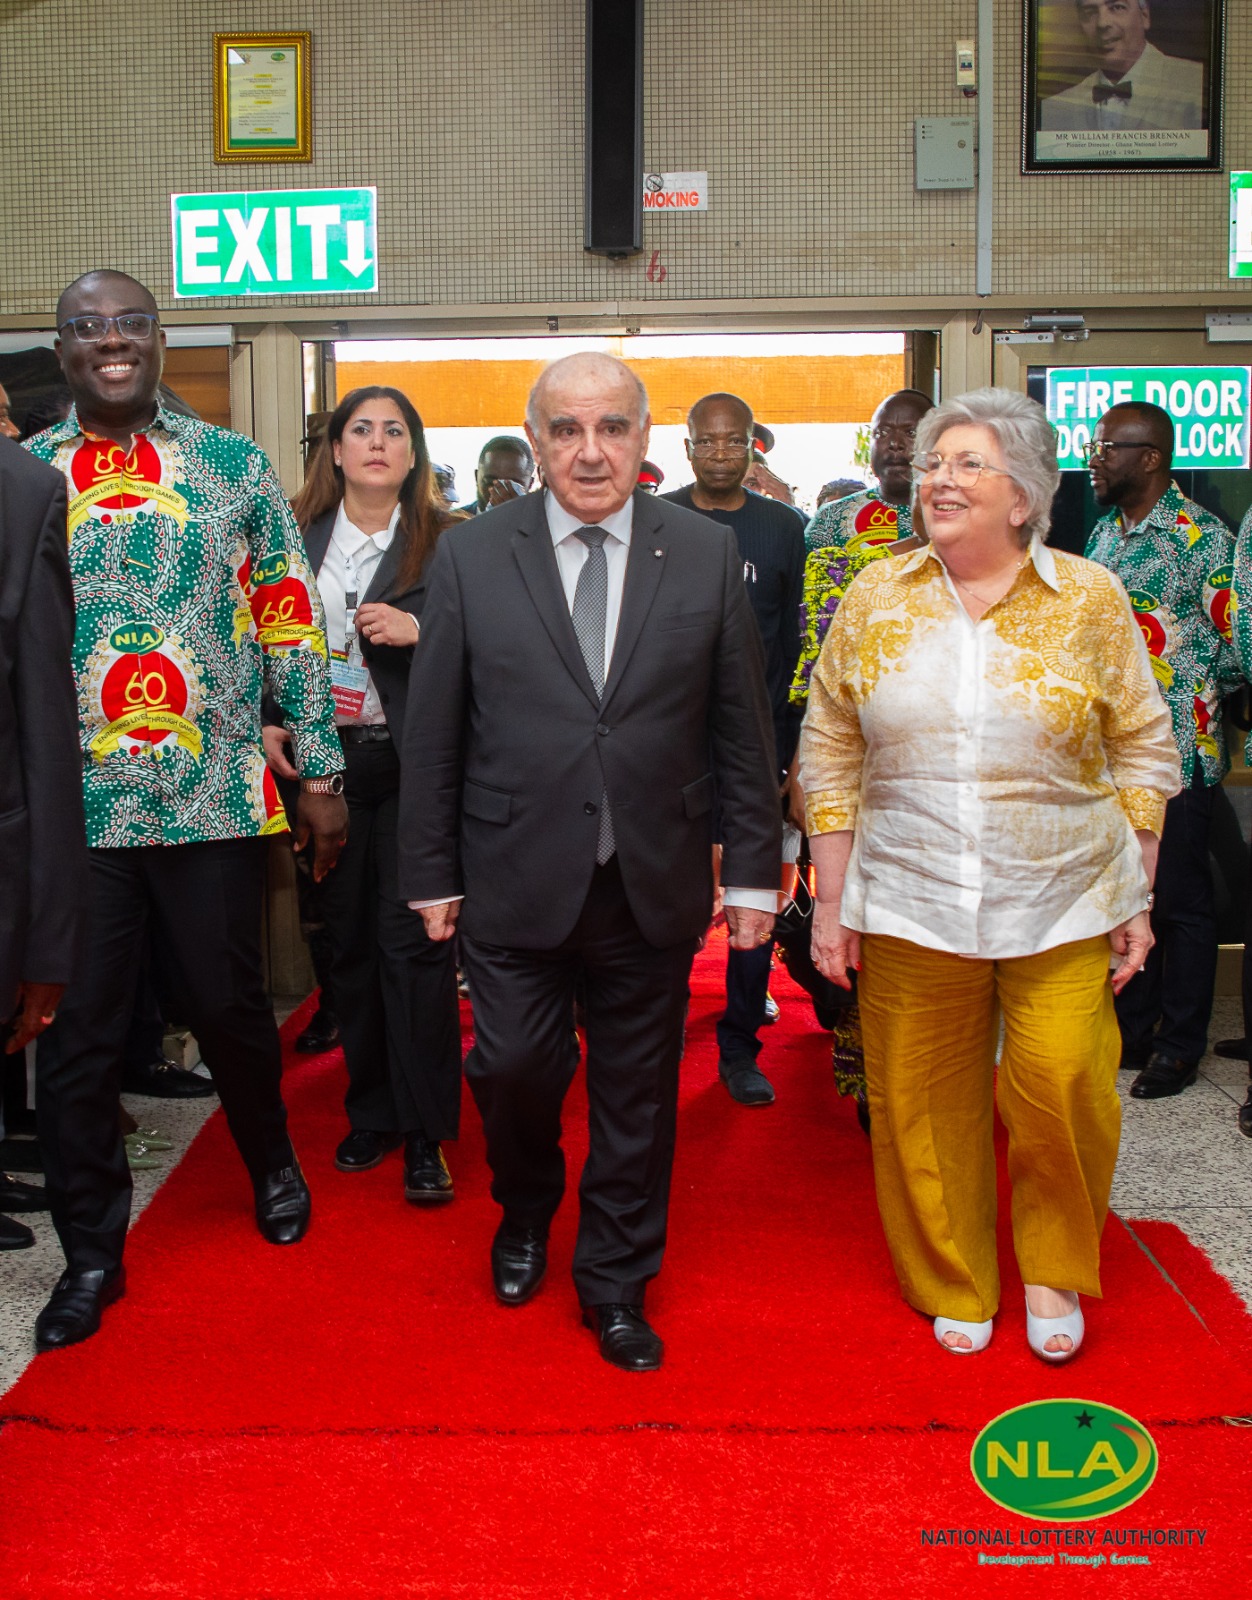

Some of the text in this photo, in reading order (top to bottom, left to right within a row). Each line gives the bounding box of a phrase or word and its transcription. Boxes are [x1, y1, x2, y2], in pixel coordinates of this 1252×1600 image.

[1072, 132, 1109, 140] WILLIAM
[1112, 132, 1147, 140] FRANCIS
[1150, 132, 1190, 140] BRENNAN
[643, 191, 699, 208] MOKING
[180, 205, 341, 284] EXIT
[1056, 380, 1243, 419] FIRE DOOR
[94, 446, 138, 474] 60
[67, 481, 180, 515] NRICHING LIVES THROUGH GAMES
[253, 561, 286, 581] NLA
[260, 596, 296, 626] 60
[125, 672, 167, 705] 60
[97, 719, 131, 744] ENRICHING
[179, 722, 198, 736] GAMES
